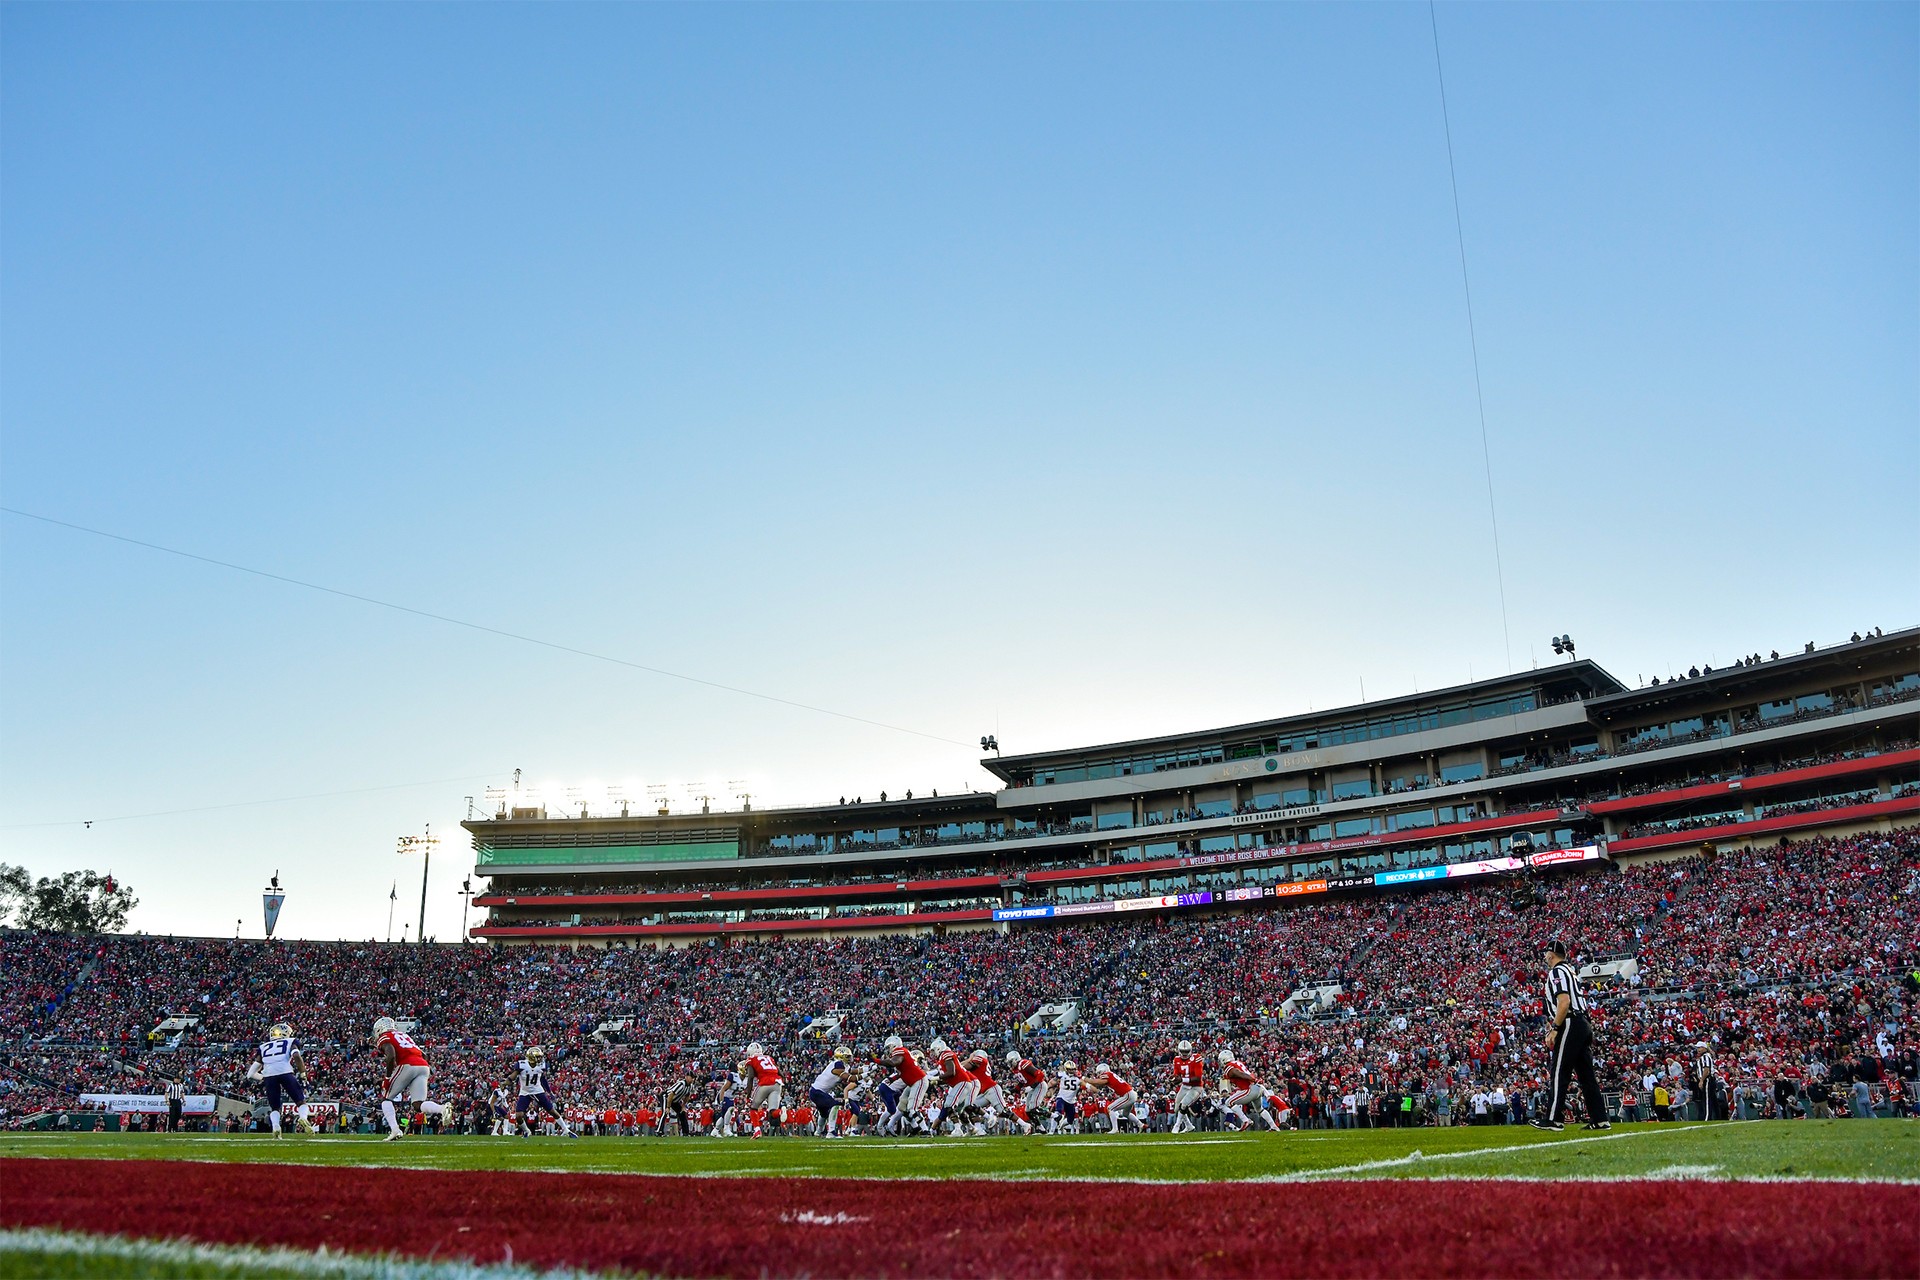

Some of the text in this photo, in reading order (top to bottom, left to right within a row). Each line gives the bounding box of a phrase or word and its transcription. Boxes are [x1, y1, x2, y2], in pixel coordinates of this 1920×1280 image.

[1190, 848, 1287, 865] WELCOME TO THE ROSE BOWL GAME
[1534, 850, 1583, 864] FARMER JOHN
[1264, 887, 1275, 896] 21
[1278, 884, 1303, 895] 10:25
[1216, 892, 1223, 901] 3
[998, 908, 1047, 919] TOYO TIRES
[262, 1040, 288, 1057] 23
[757, 1056, 777, 1070] 21
[1181, 1065, 1189, 1077] 7
[526, 1073, 539, 1087] 14
[1063, 1079, 1077, 1091] 55
